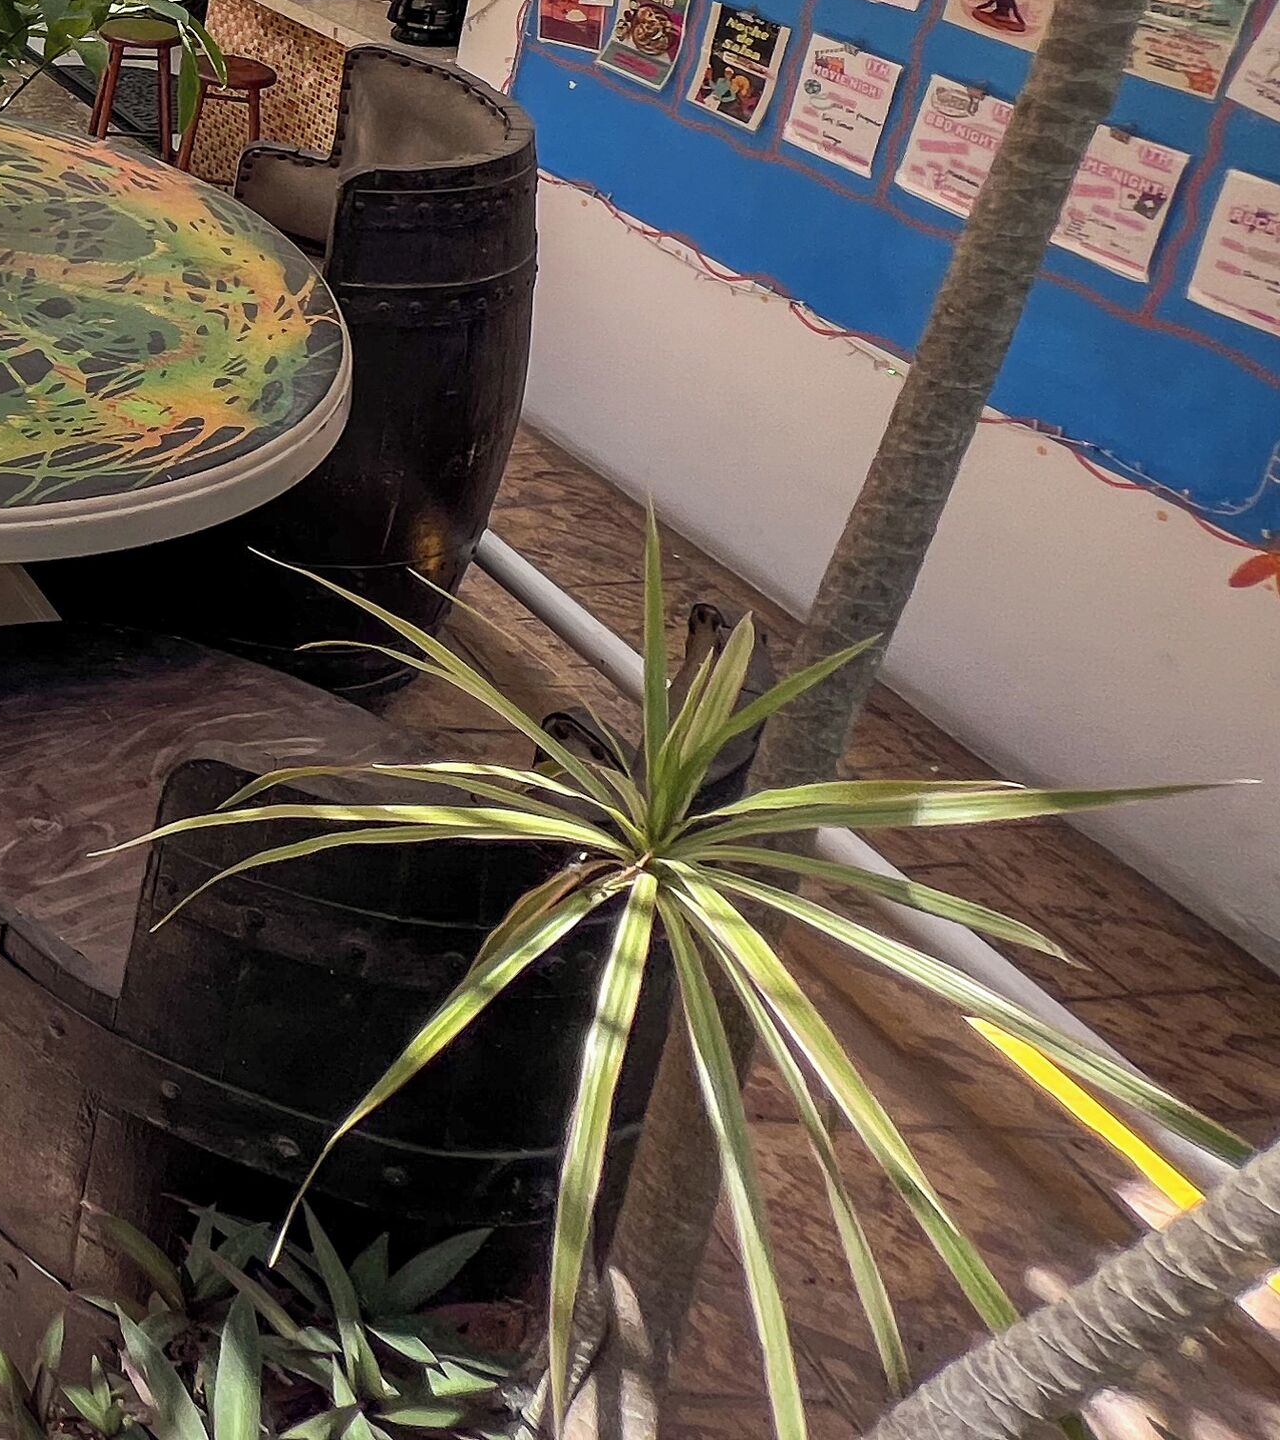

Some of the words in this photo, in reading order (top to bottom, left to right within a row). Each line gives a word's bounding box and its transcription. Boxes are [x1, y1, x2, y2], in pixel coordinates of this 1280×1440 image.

[813, 63, 849, 86] MOVIE
[850, 78, 883, 99] NIGHT
[955, 124, 998, 150] NIGHT
